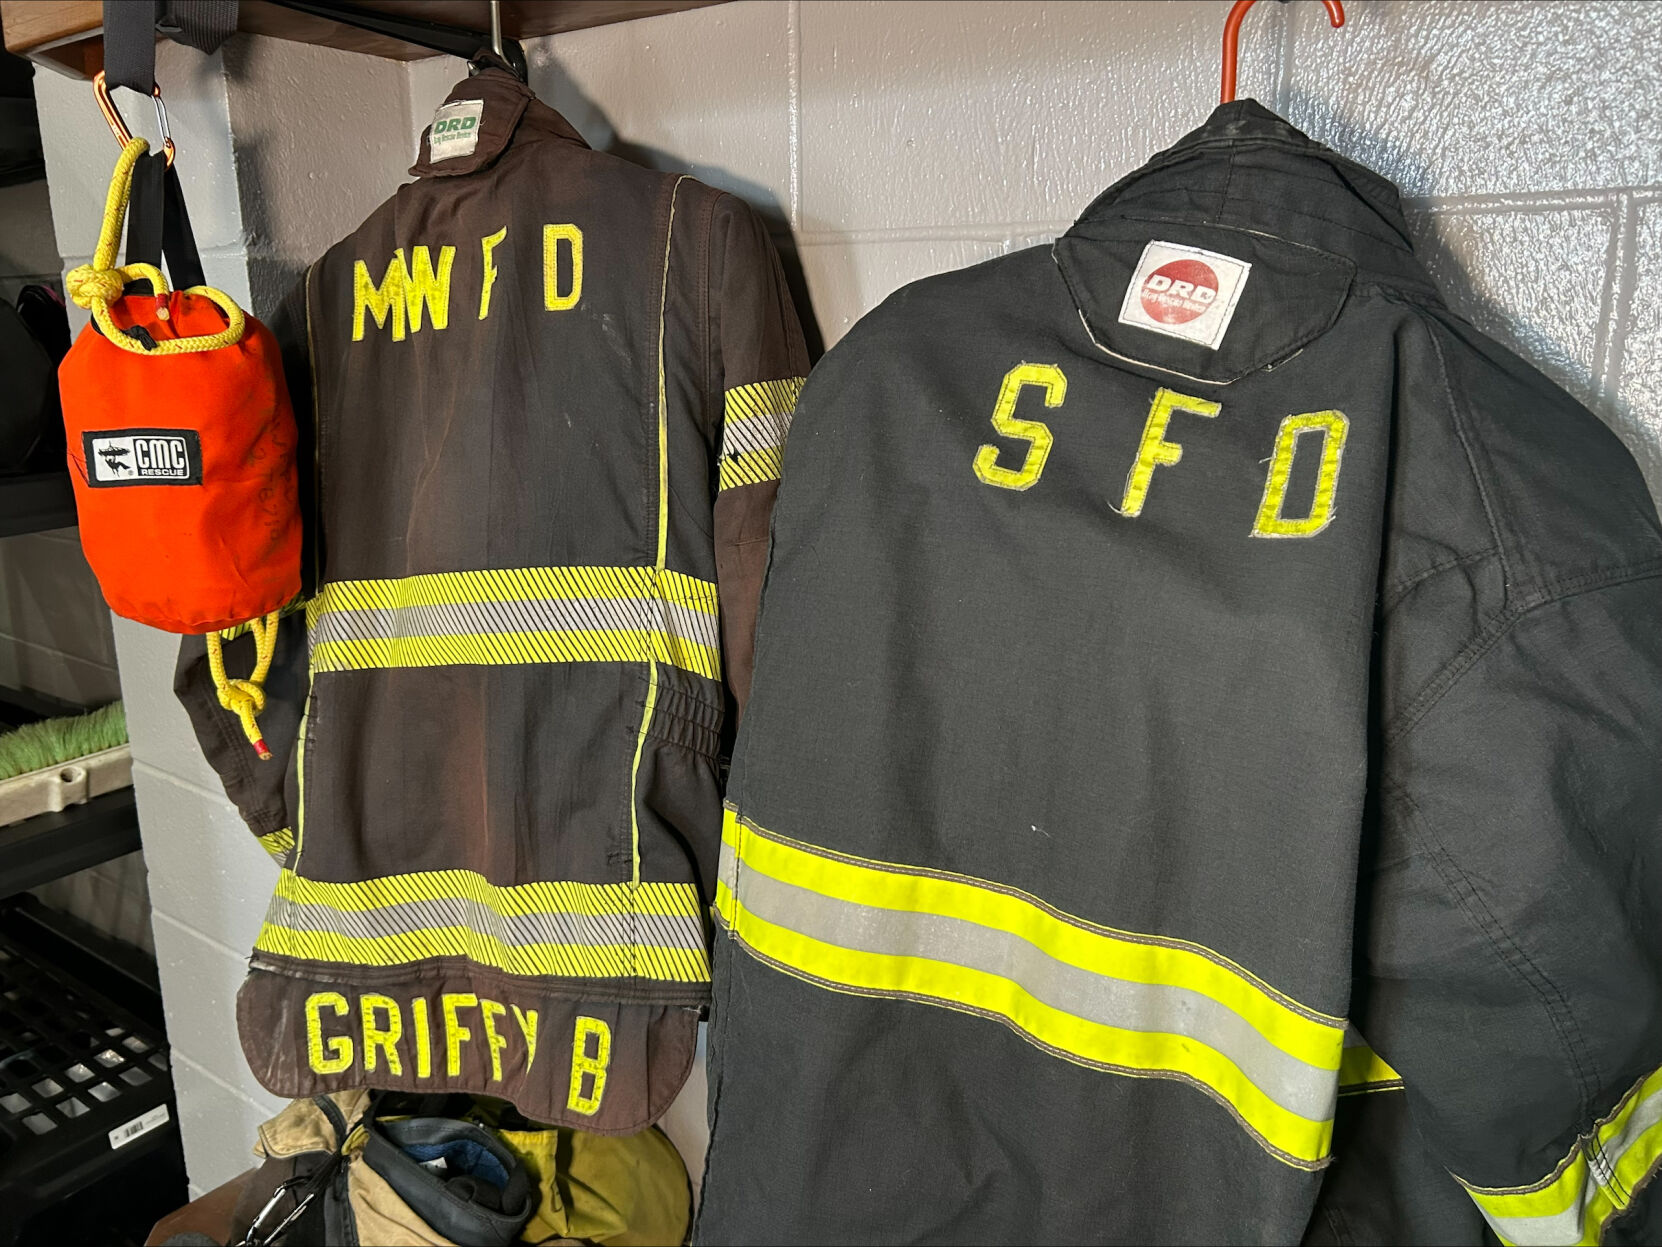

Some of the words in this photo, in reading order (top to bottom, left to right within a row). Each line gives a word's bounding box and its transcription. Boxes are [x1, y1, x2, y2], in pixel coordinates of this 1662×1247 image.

[433, 116, 477, 135] DRD
[1146, 274, 1217, 305] DRD
[135, 439, 185, 469] CMC
[141, 469, 185, 477] RESCUE
[566, 1015, 612, 1117] B
